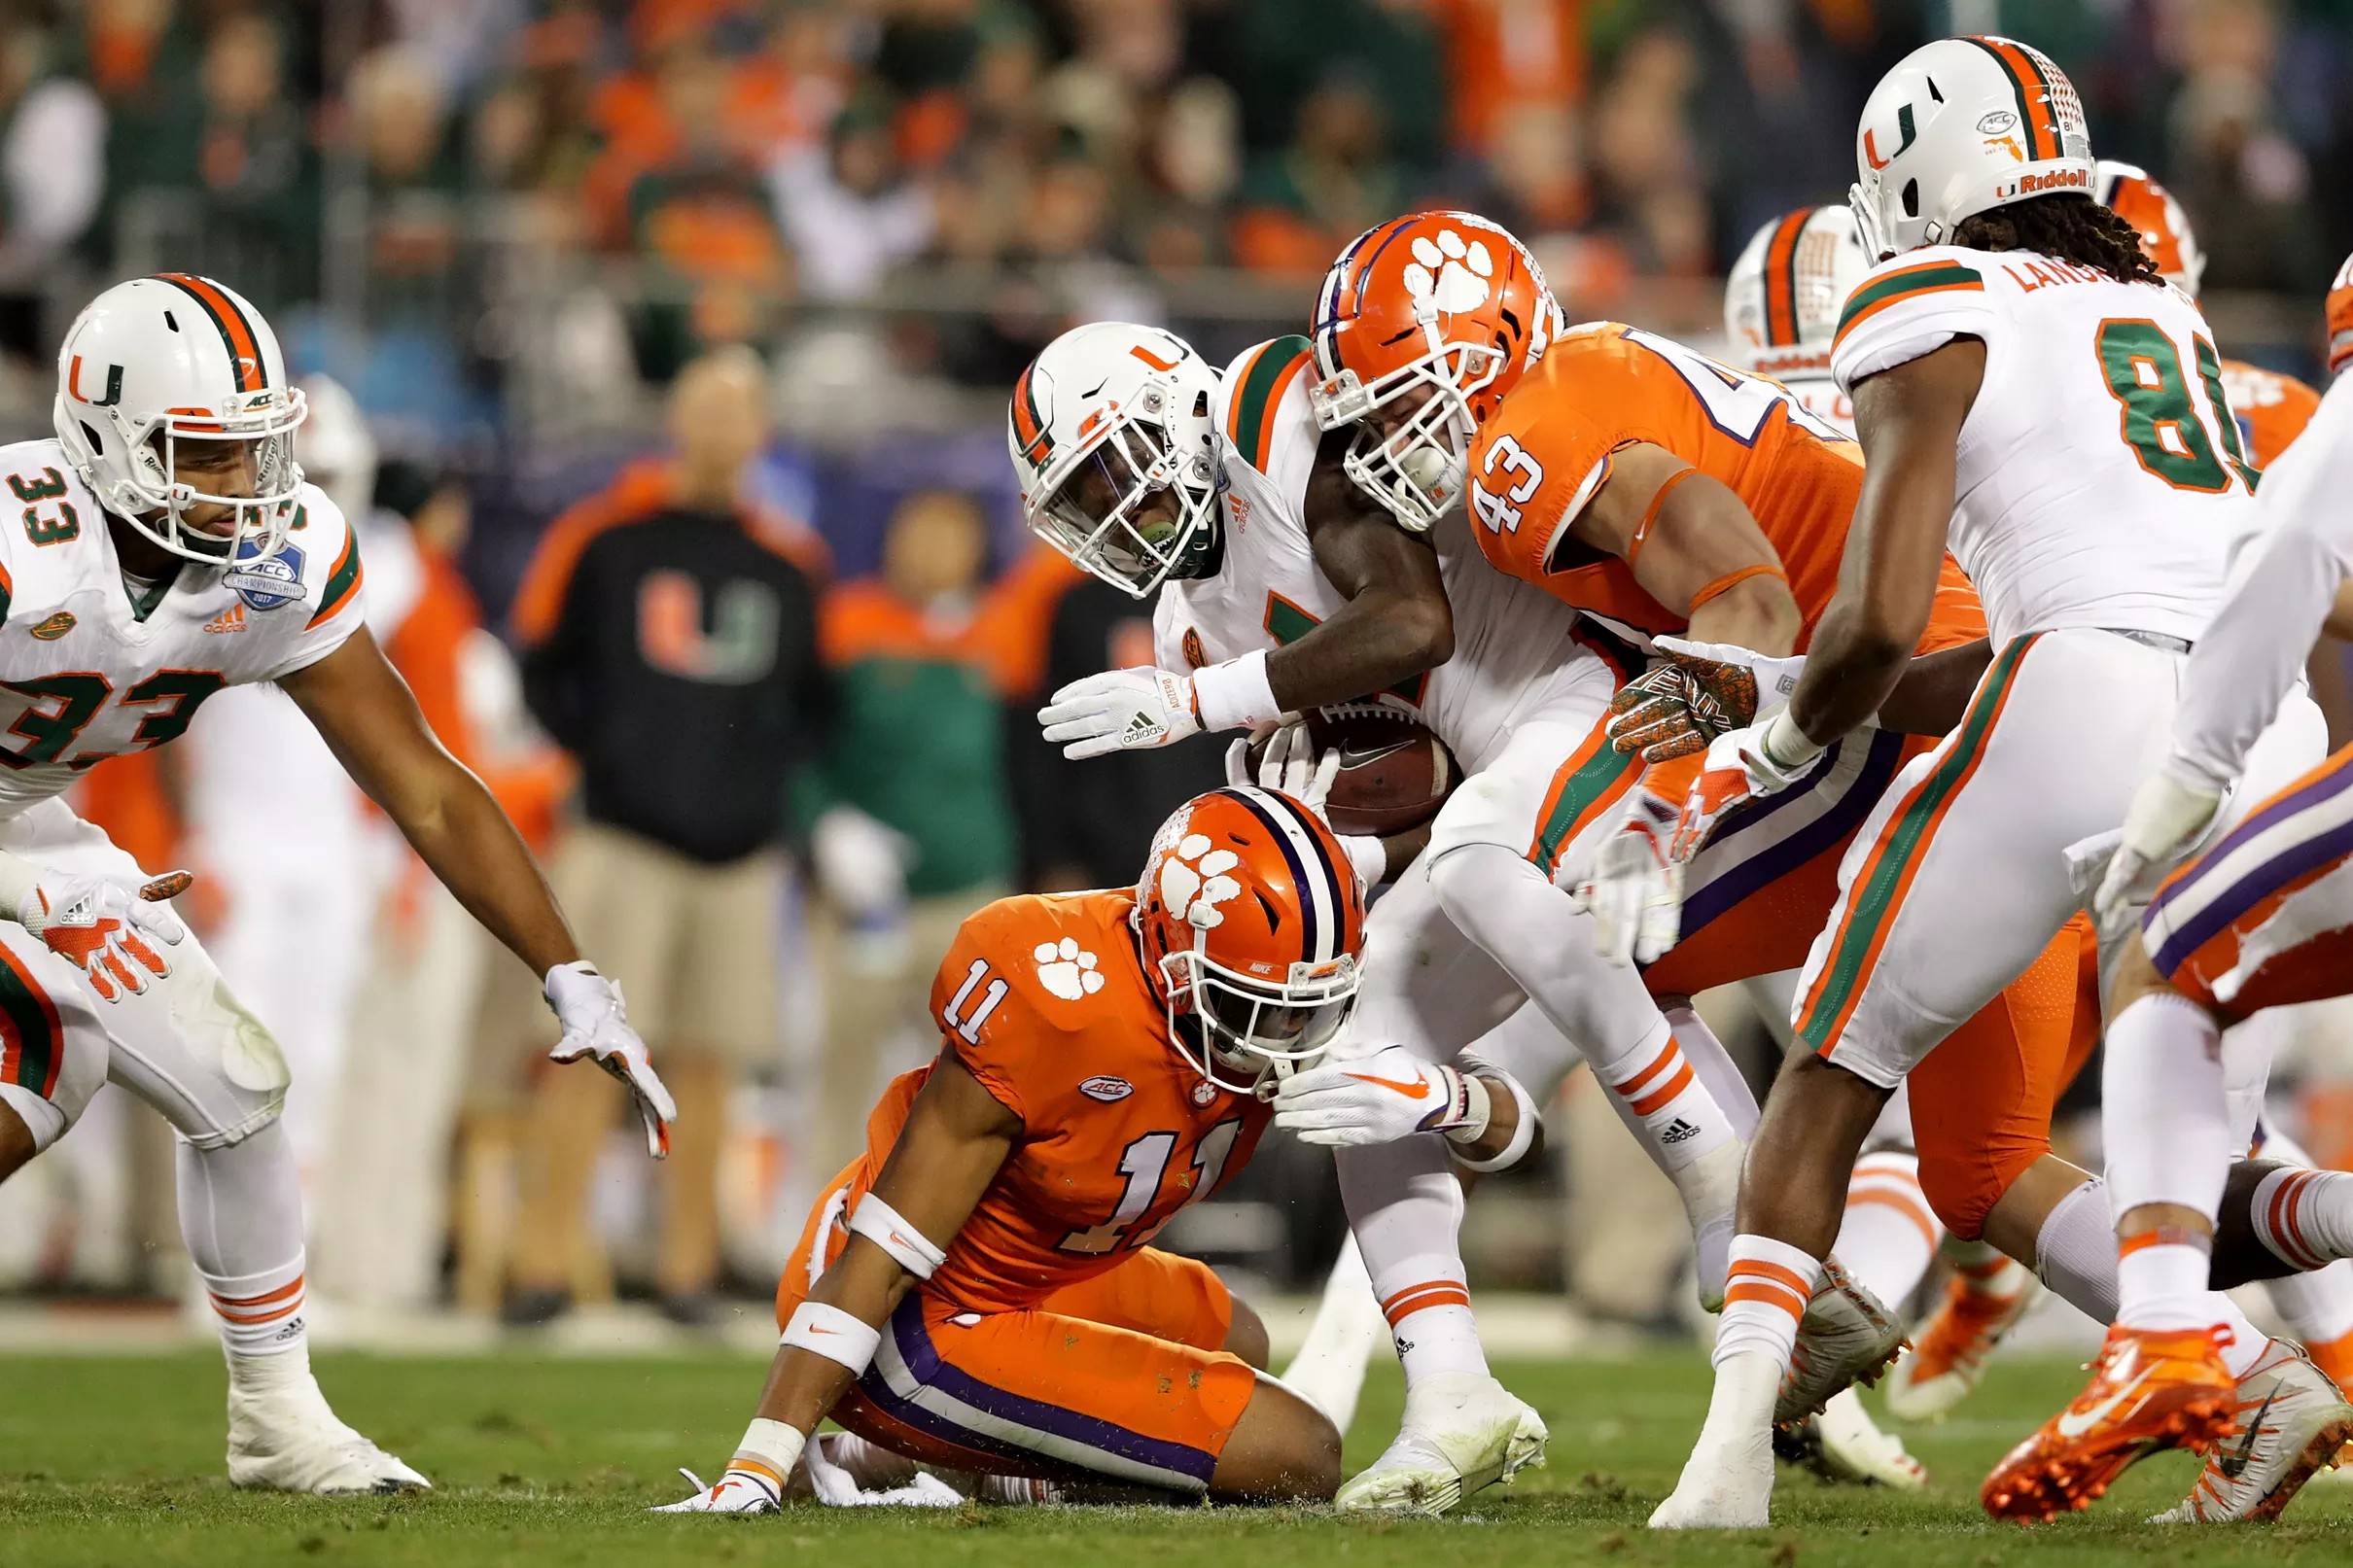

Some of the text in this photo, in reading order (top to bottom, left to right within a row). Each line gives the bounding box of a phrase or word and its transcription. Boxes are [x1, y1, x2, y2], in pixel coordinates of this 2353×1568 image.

[1864, 103, 1916, 169] U
[1996, 184, 2016, 197] U
[2019, 168, 2087, 194] Riddell
[1130, 334, 1190, 371] U
[69, 355, 124, 407] U
[245, 393, 273, 408] ACC
[2094, 318, 2264, 497] 81
[257, 437, 278, 482] Riddell
[172, 488, 189, 501] U
[1472, 434, 1544, 536] 43
[6, 467, 81, 547] 33
[231, 576, 299, 595] CHAMPIONSHIP
[248, 564, 287, 576] ACC
[253, 593, 272, 604] 2017
[636, 567, 781, 686] U
[1123, 724, 1165, 745] adidas
[1249, 962, 1273, 975] NIKE
[942, 958, 1010, 1047] 11
[1086, 1082, 1128, 1094] ACC
[1053, 1118, 1244, 1255] 11
